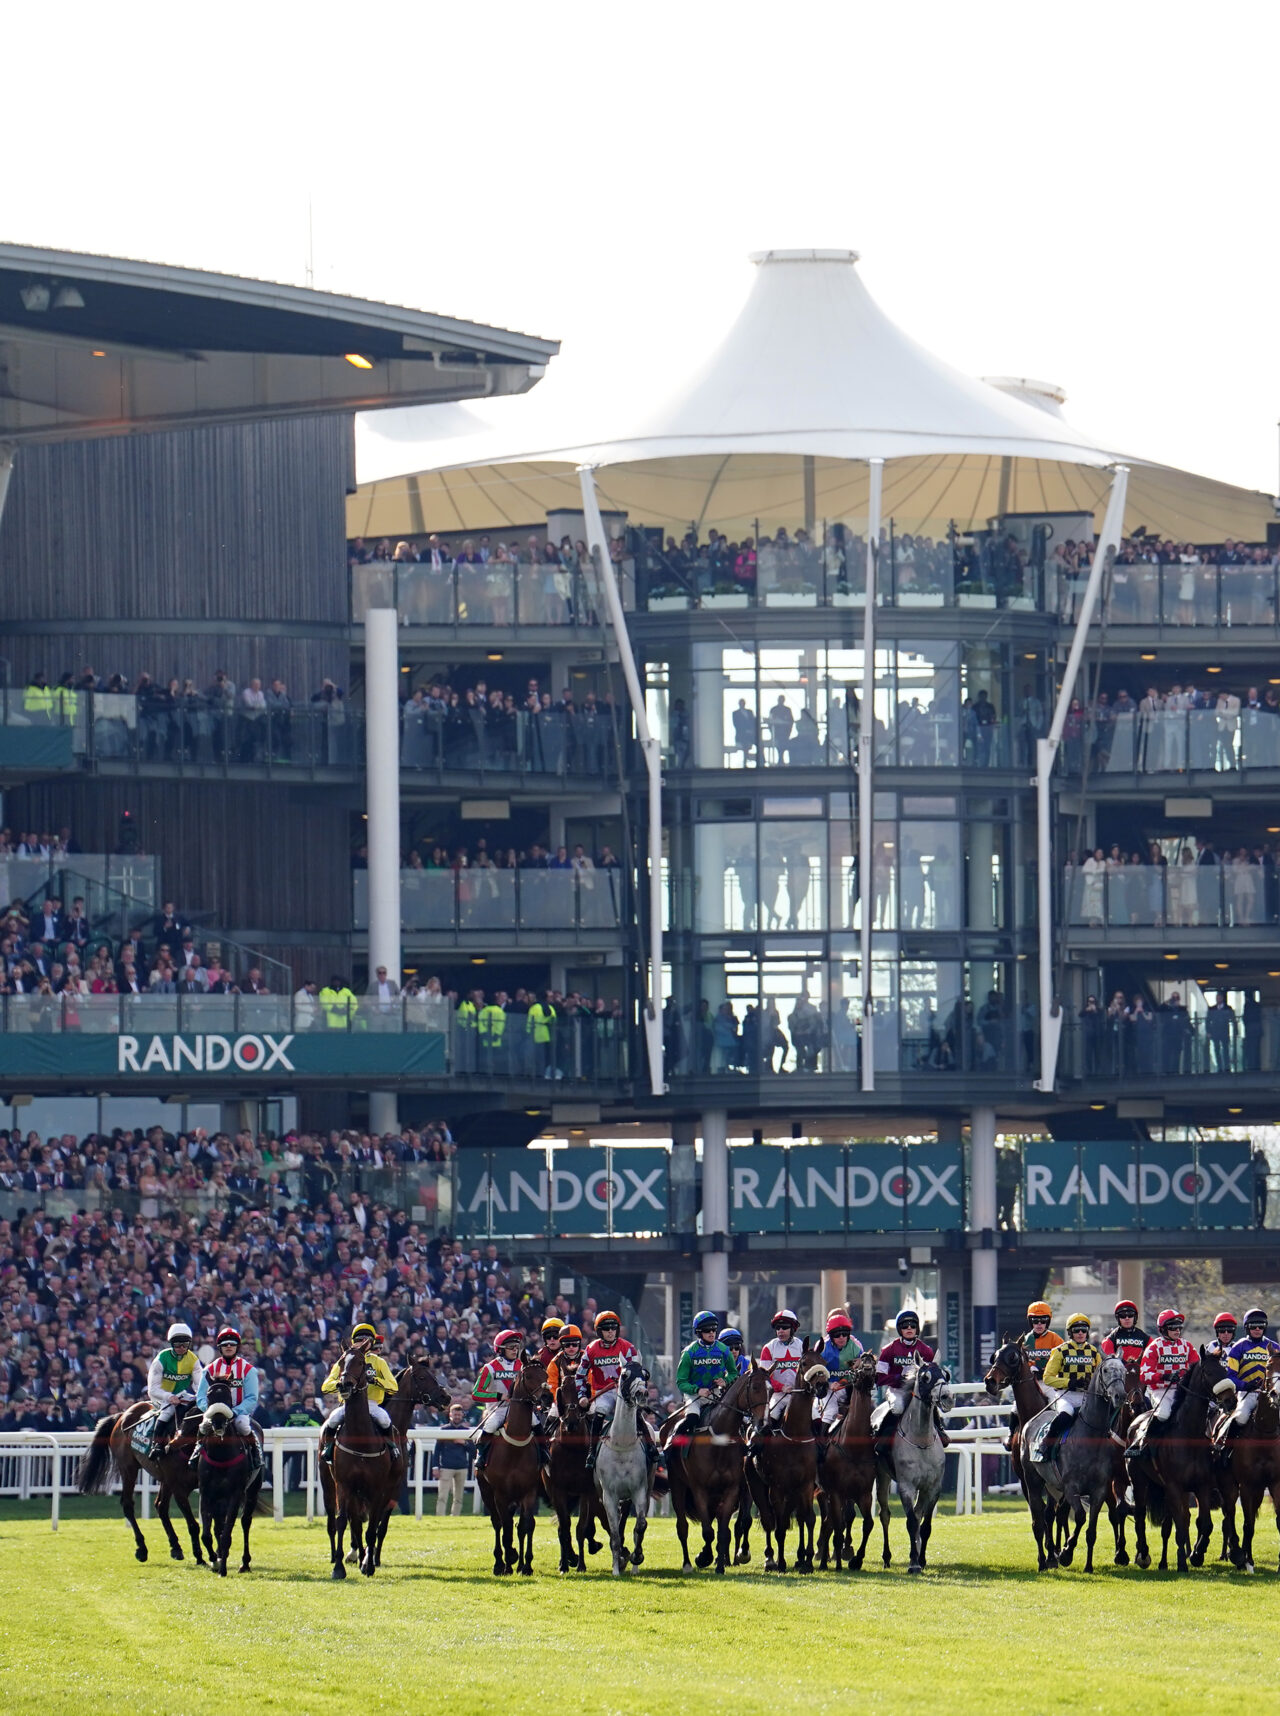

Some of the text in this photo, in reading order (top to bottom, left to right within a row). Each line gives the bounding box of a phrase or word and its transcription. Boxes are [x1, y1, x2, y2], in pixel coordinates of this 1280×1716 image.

[118, 1034, 295, 1072] RANDOX
[734, 1164, 960, 1208] RANDOX
[1027, 1162, 1251, 1205] RANDOX
[948, 1300, 958, 1358] HEALTH
[1116, 1338, 1143, 1346] RANDOX
[693, 1358, 721, 1366] RANDOX
